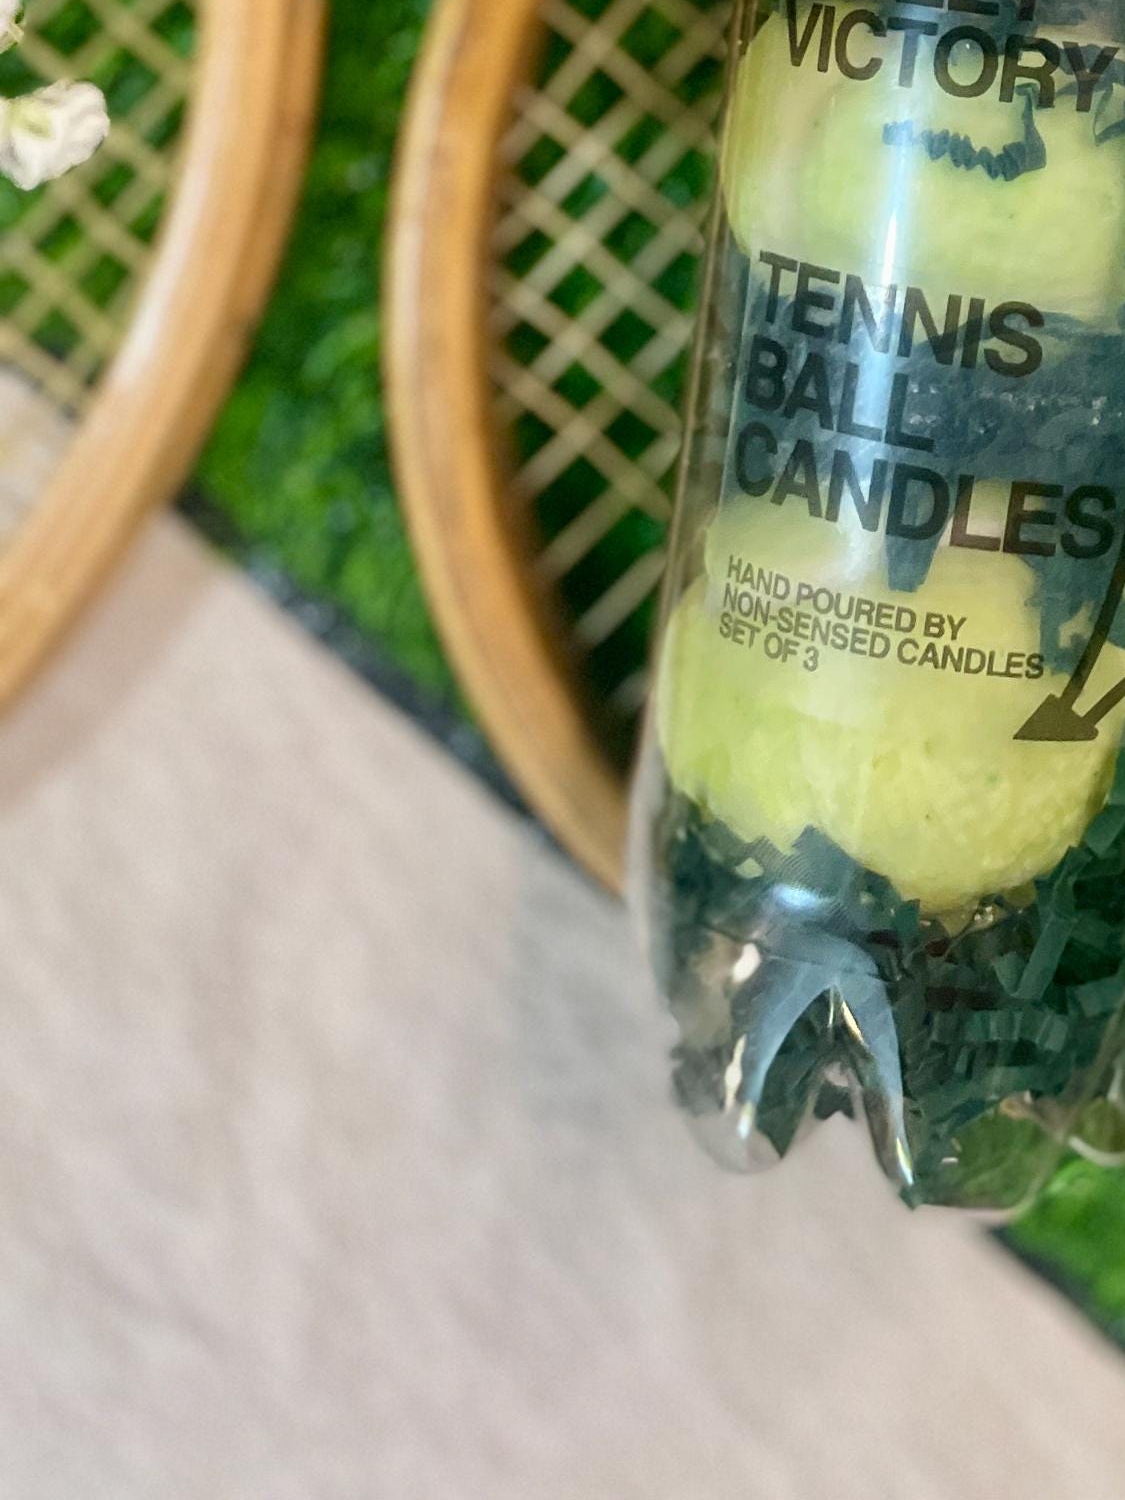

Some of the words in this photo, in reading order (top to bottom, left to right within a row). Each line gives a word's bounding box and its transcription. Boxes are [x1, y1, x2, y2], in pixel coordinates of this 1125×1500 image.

[758, 250, 1044, 378] TENNIS
[746, 334, 935, 452] BALL
[735, 421, 1117, 560] CANDLES
[719, 613, 761, 647] SET
[763, 632, 798, 664] OF
[803, 647, 820, 673] 3
[723, 582, 891, 659] NON-SENSED
[897, 638, 1045, 679] CANDLES
[727, 555, 791, 601] HAND
[796, 582, 916, 634] POURED
[923, 612, 967, 641] BY
